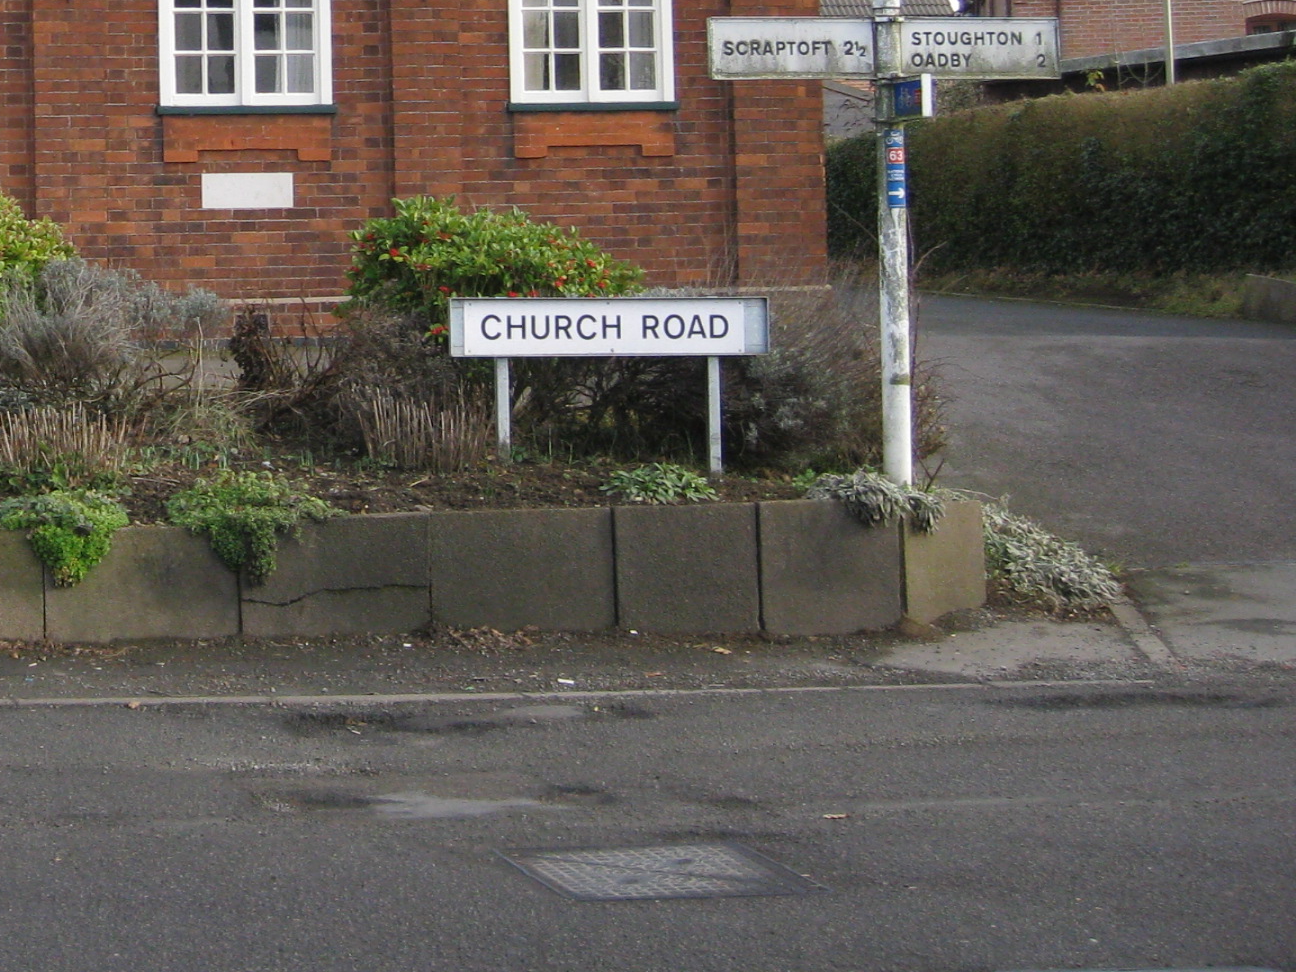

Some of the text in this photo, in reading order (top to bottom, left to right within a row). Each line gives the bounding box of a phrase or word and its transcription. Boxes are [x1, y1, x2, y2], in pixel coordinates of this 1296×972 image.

[911, 31, 1042, 46] STOUGHTON 1
[723, 40, 832, 56] SCRAPTOFT
[911, 53, 1046, 68] OADBY 2
[889, 150, 904, 161] 63
[480, 313, 730, 341] CHURCH ROAD
